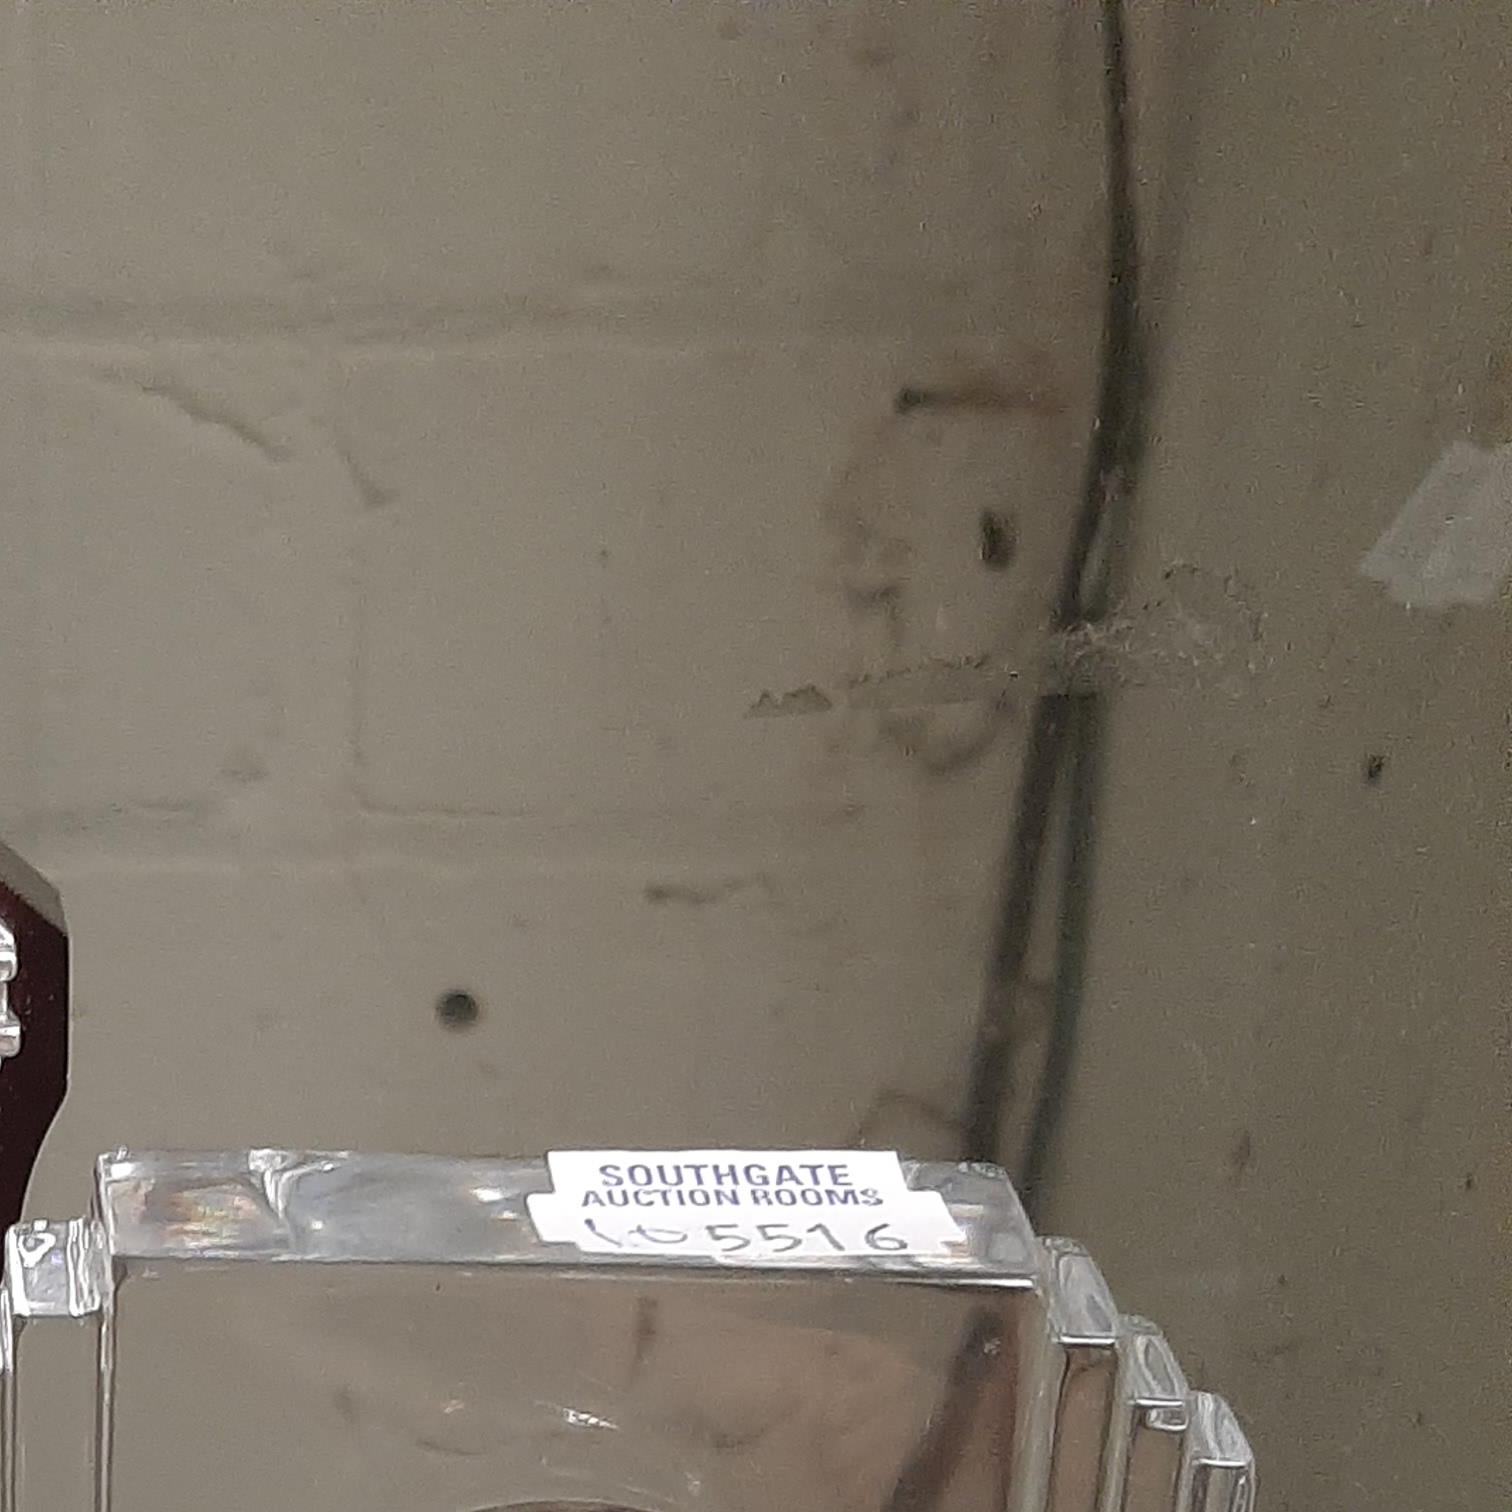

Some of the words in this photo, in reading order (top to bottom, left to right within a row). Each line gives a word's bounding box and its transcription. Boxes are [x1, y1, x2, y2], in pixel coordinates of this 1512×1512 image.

[599, 1164, 853, 1187] SOUTHGATE
[582, 1188, 740, 1207] AUCTION
[750, 1188, 884, 1207] ROOMS
[705, 1222, 909, 1252] 5516
